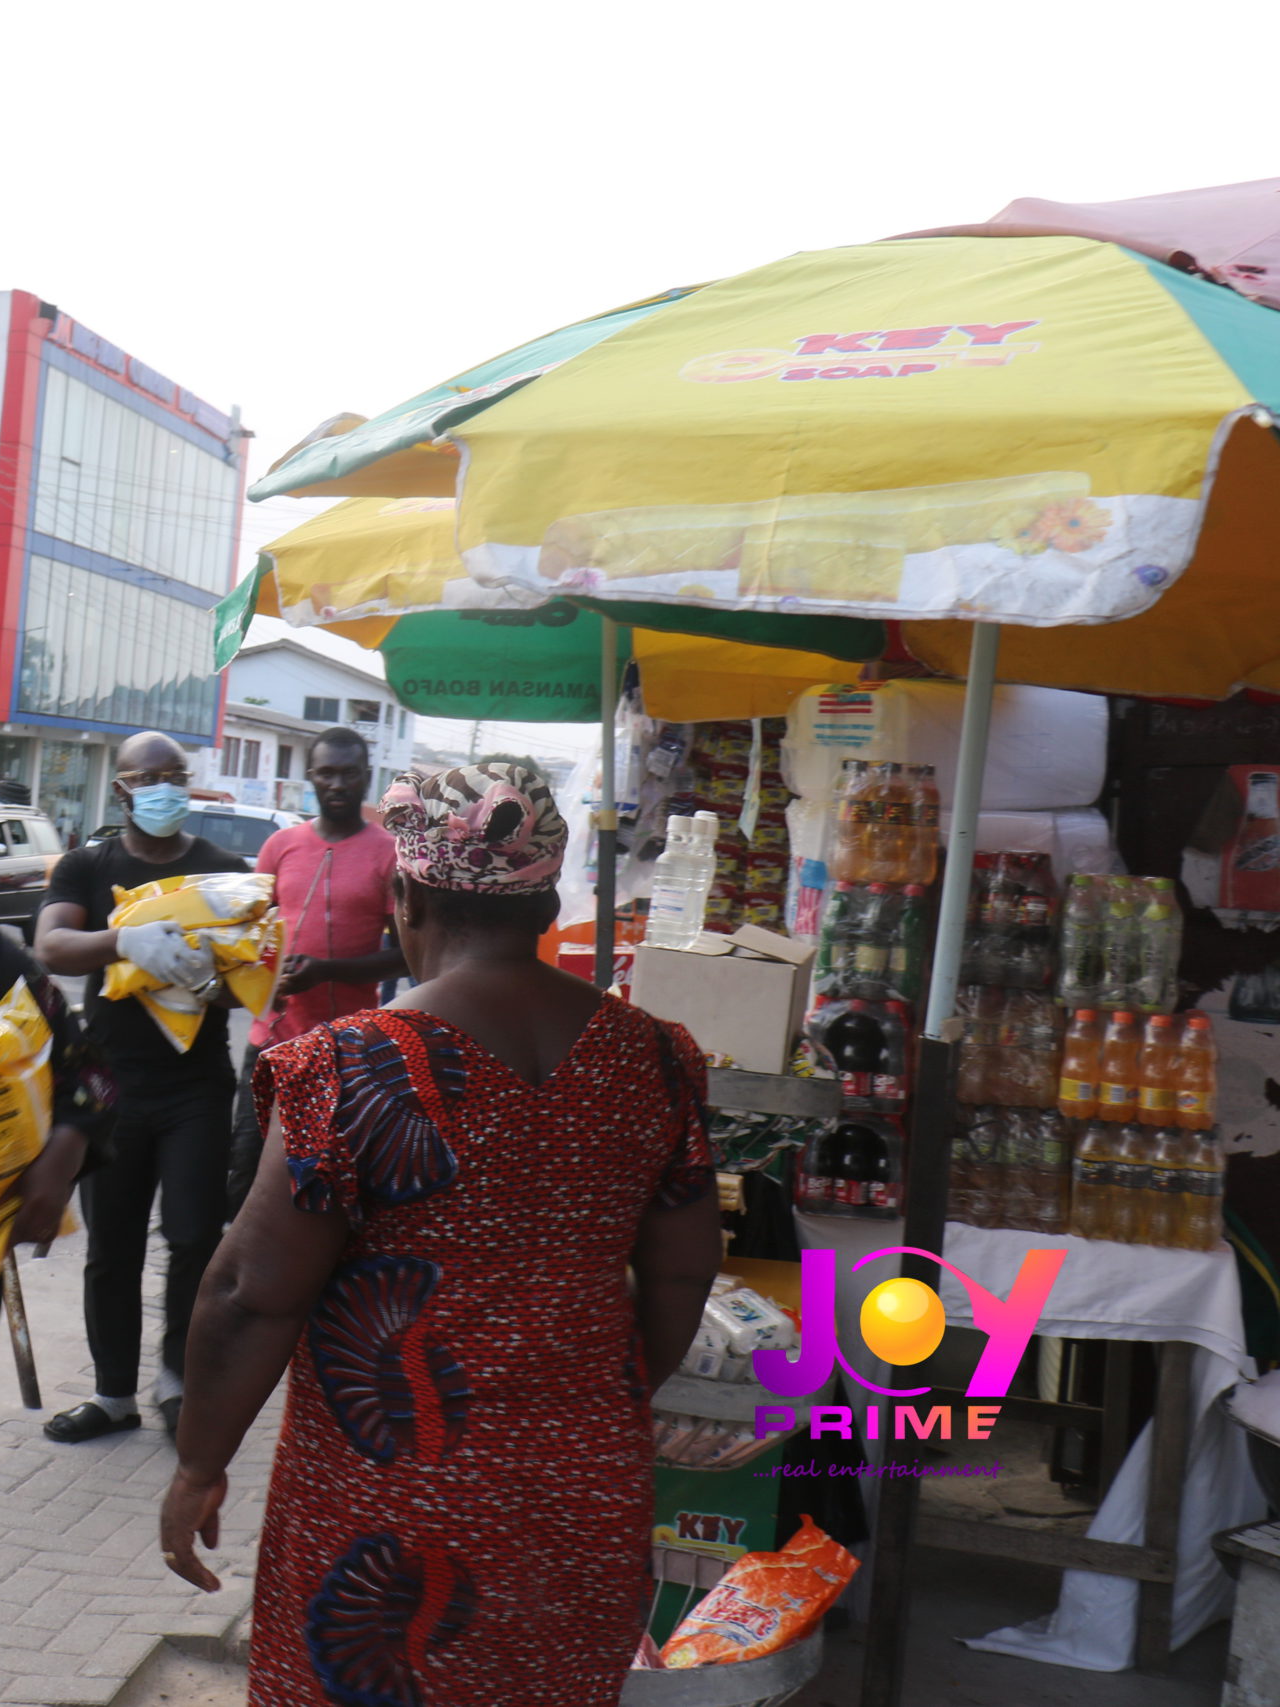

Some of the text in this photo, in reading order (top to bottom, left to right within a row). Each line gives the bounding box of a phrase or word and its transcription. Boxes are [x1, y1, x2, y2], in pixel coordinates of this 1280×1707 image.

[795, 320, 1040, 355] KEY
[780, 363, 937, 381] SOAP
[675, 1511, 748, 1546] KEY
